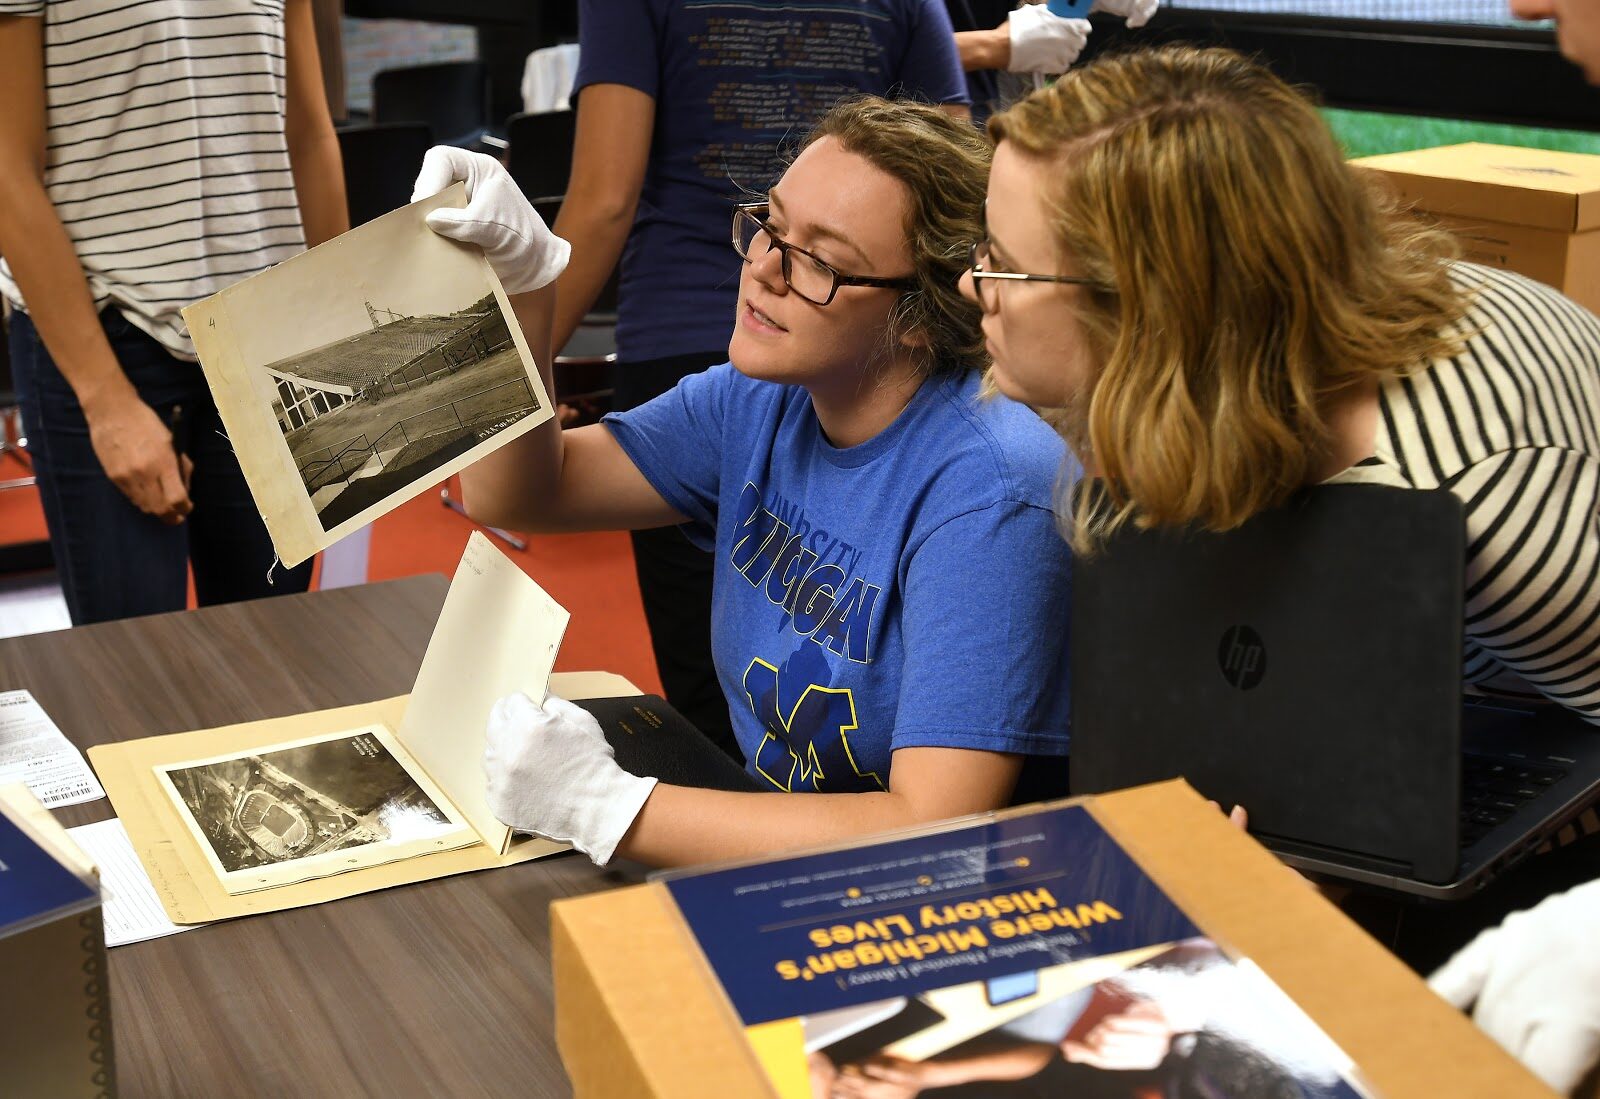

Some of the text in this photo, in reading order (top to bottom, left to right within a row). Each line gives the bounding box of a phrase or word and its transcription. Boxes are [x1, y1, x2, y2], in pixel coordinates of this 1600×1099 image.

[208, 317, 216, 329] 4
[1222, 625, 1263, 689] hp
[775, 899, 1124, 982] Where Michigan's
[808, 887, 1058, 948] History Lives
